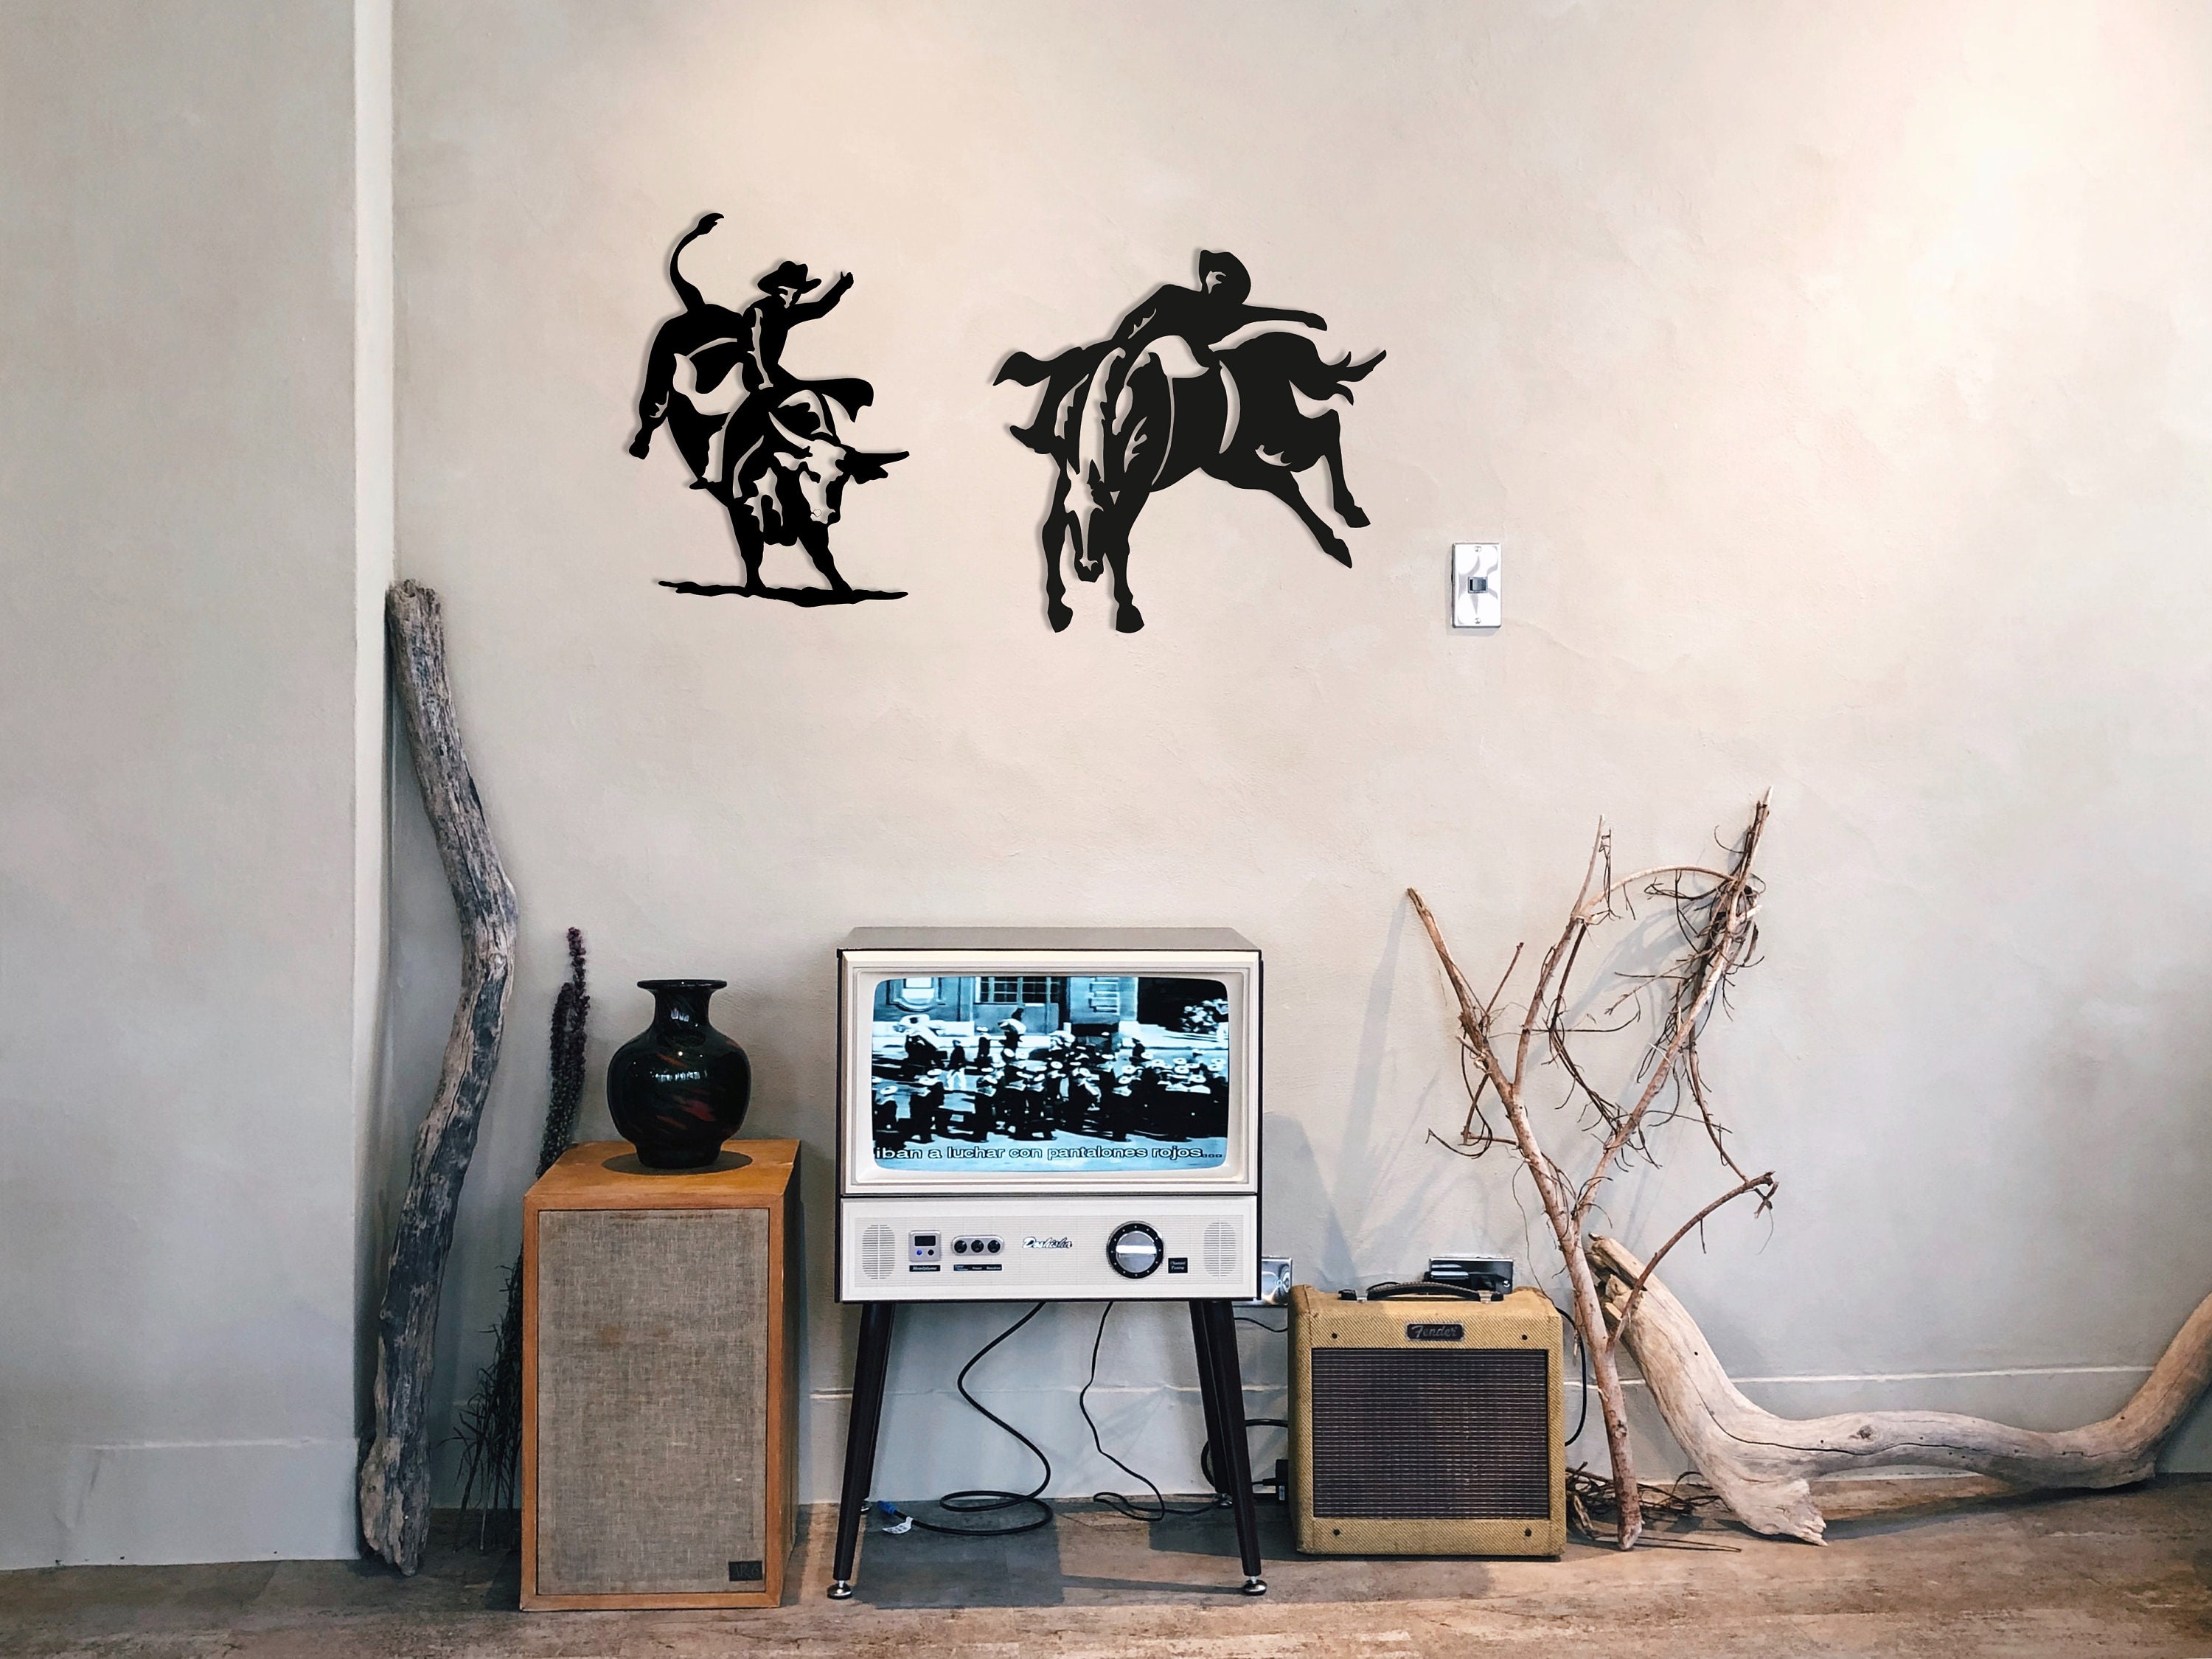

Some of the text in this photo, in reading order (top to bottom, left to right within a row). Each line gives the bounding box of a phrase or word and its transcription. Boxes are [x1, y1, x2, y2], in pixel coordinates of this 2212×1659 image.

[875, 1147, 922, 1159] iban
[928, 1149, 942, 1158] a
[947, 1146, 1005, 1158] luchar
[1009, 1148, 1043, 1158] con
[1047, 1146, 1148, 1160] pantalones
[1411, 1325, 1458, 1338] Fender
